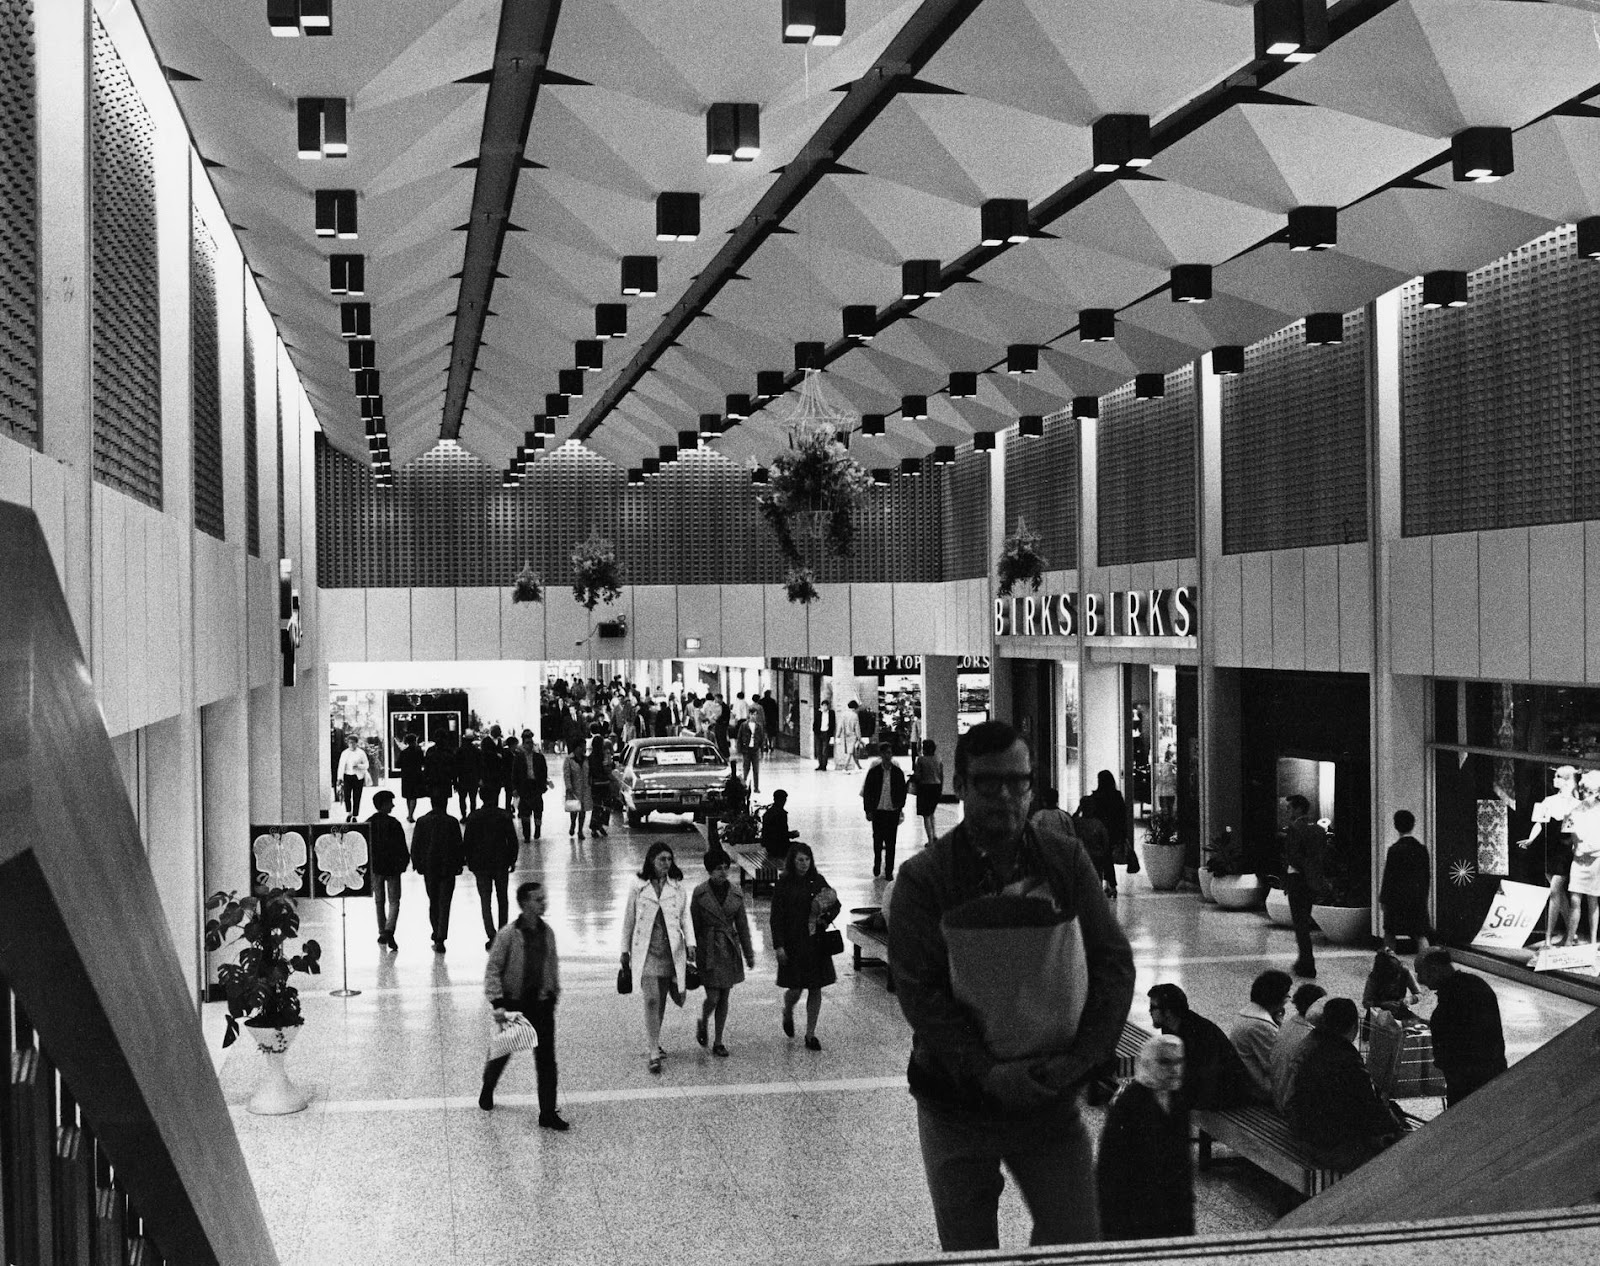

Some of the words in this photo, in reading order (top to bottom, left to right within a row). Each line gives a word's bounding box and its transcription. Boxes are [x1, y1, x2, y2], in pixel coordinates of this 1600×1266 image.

[866, 655, 890, 670] TIP
[896, 655, 921, 669] TOP
[1489, 905, 1531, 929] Sale
